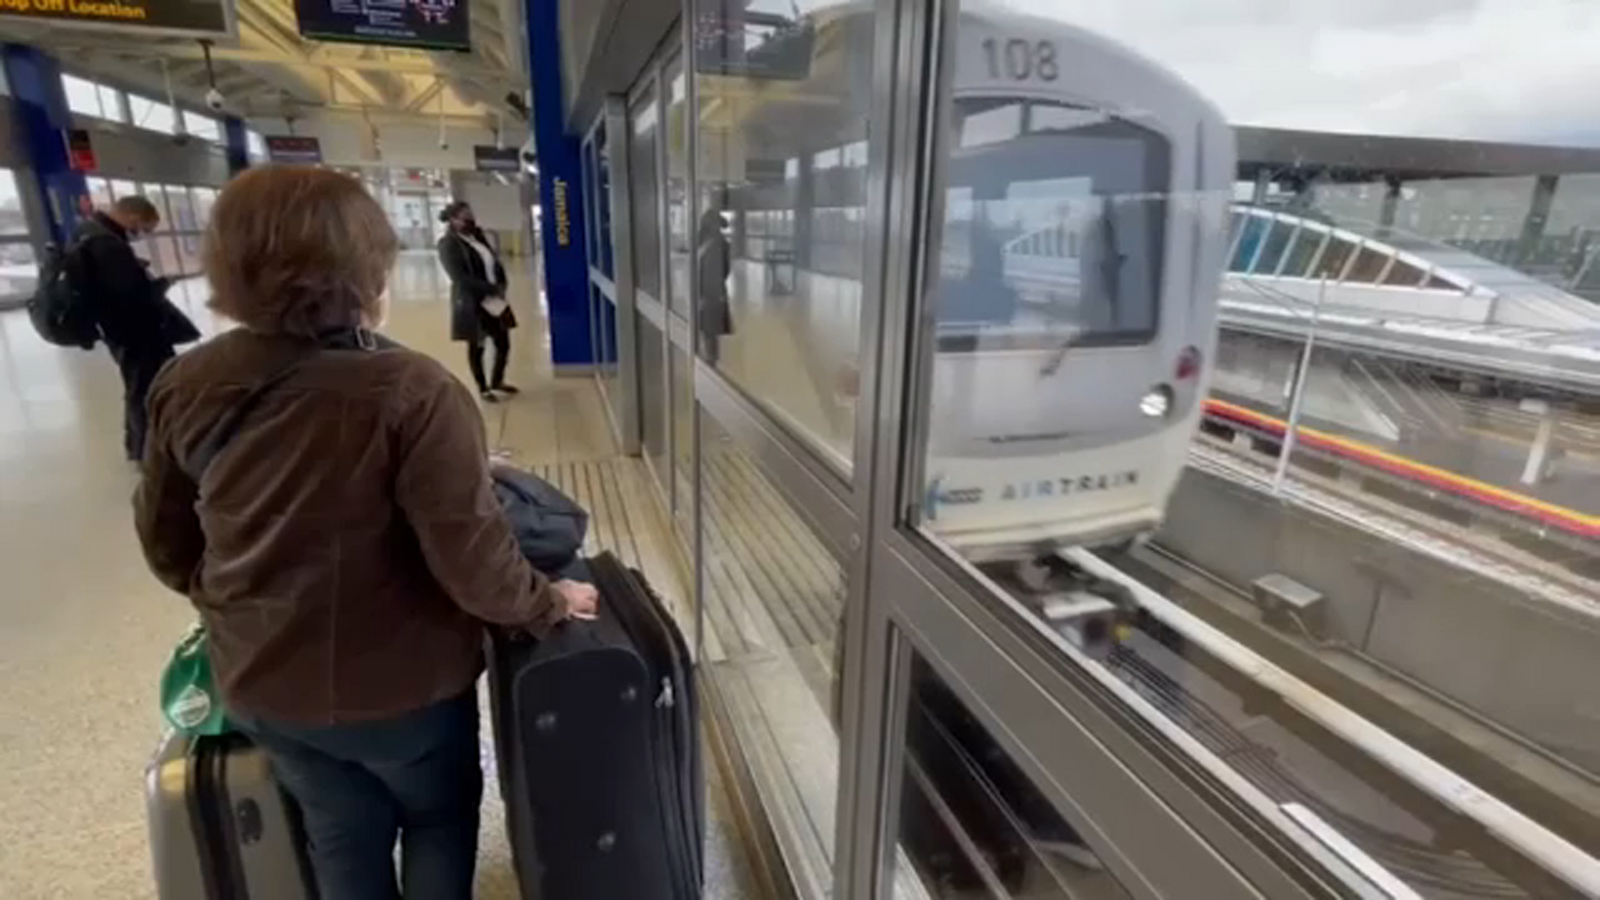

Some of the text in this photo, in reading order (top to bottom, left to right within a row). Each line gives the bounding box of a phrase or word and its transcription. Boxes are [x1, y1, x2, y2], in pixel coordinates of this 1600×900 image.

[69, 0, 146, 18] Location
[981, 37, 1059, 81] 108
[554, 177, 570, 246] Jamaica
[1002, 471, 1138, 500] AIRTRAIN
